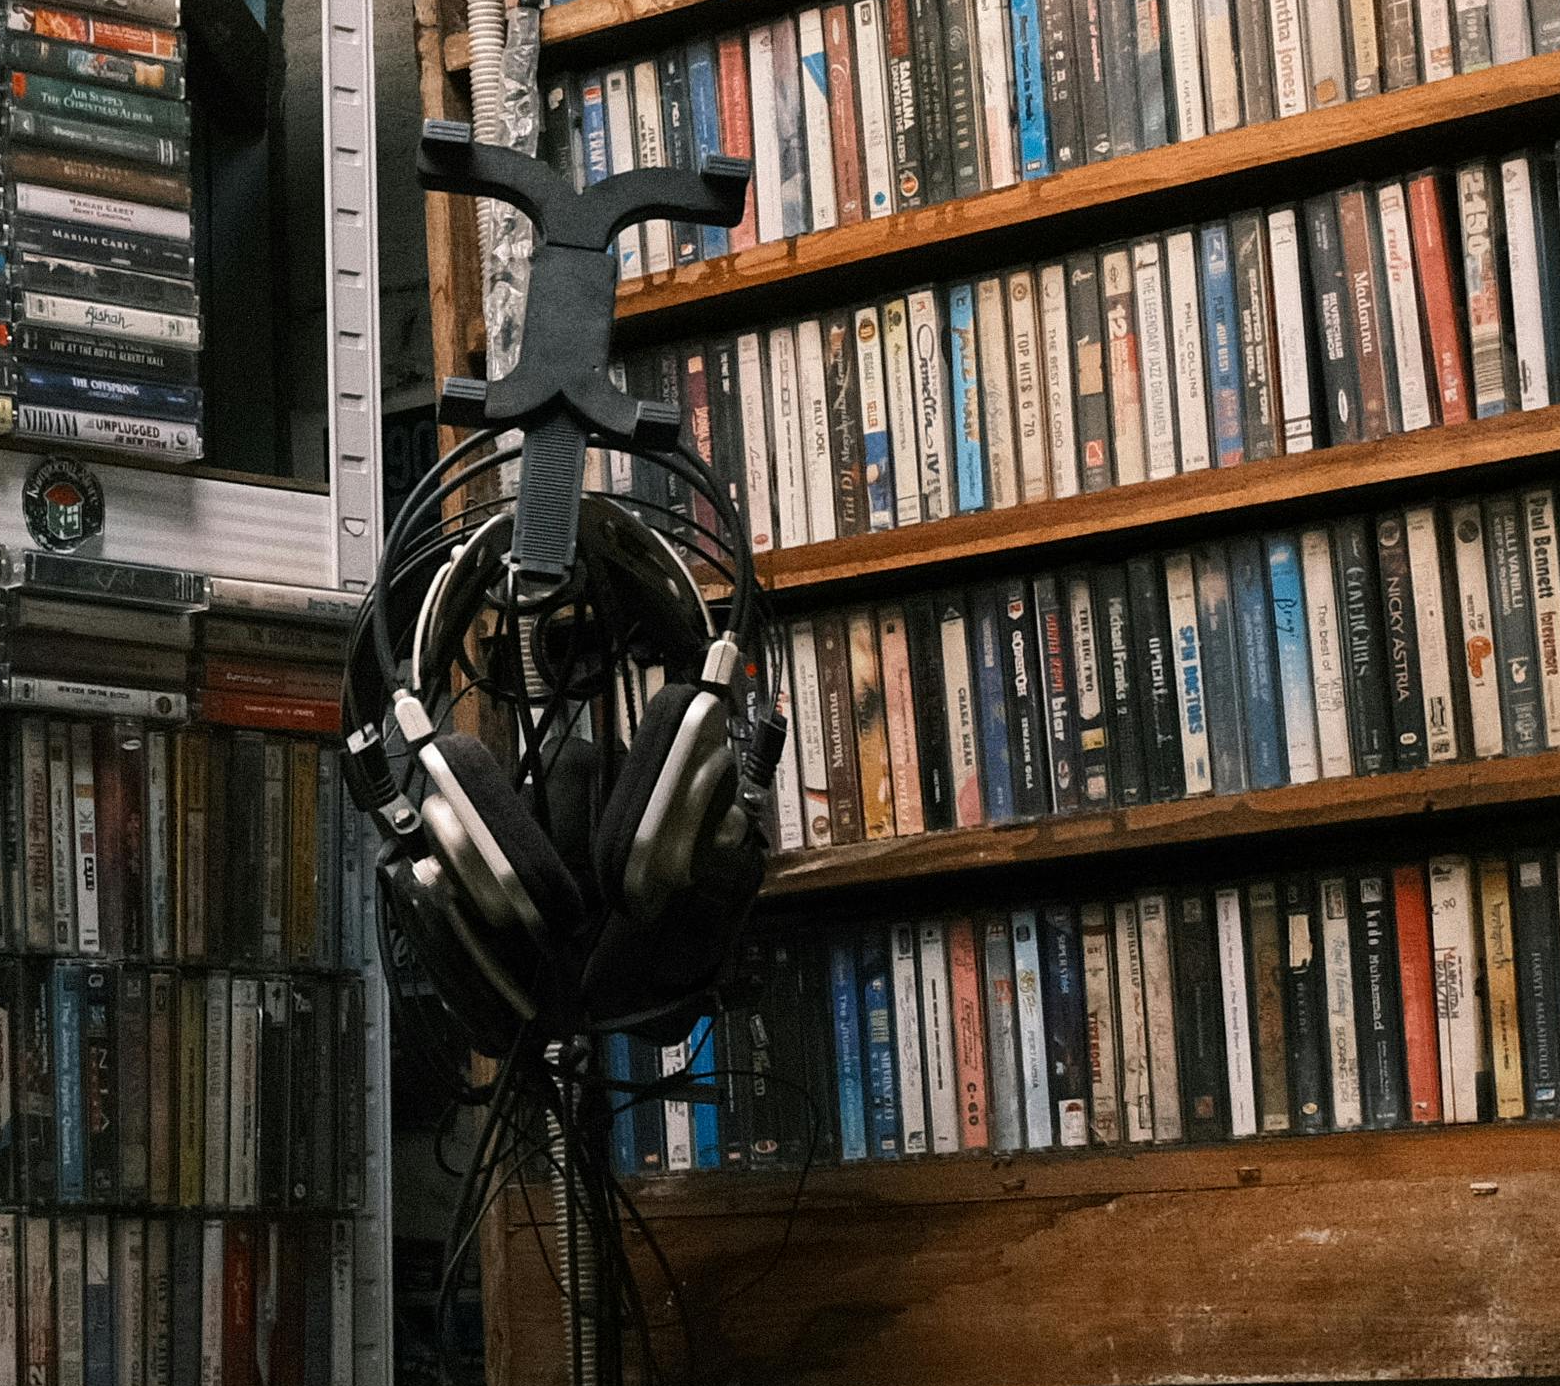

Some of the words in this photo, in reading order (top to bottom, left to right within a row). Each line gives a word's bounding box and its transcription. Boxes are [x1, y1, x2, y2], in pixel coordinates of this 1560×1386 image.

[42, 92, 61, 106] THE
[900, 60, 915, 130] SANTANA
[1276, 47, 1298, 99] jones
[52, 229, 99, 245] MARIAH
[102, 239, 137, 252] CAREY
[1386, 228, 1407, 283] radja
[1142, 276, 1156, 295] THE
[1108, 303, 1127, 339] 12
[1144, 298, 1161, 353] LEGENDARY
[1353, 271, 1373, 357] Madonna
[1017, 331, 1030, 357] TOP
[1148, 357, 1164, 378] JAZZ
[91, 380, 139, 395] OFFSPRING
[916, 324, 937, 449] Camellia
[1019, 363, 1033, 393] HITS
[22, 408, 78, 437] NIRVANA
[96, 419, 160, 438] UNPLUGGED
[1151, 381, 1166, 437] DRUMMERS
[926, 452, 940, 475] IV
[1529, 497, 1547, 531] Paul
[1509, 556, 1524, 609] VANILLI
[1534, 536, 1554, 599] Bennett
[1108, 596, 1125, 650] Michael
[1386, 577, 1404, 634] NICKY
[1179, 625, 1196, 661] SPIN
[1393, 637, 1409, 701] ASTRIA
[1540, 611, 1560, 676] forevermore
[1112, 652, 1128, 700] Franks
[1184, 666, 1203, 734] DOCTORS
[829, 691, 844, 768] Madonna
[840, 1021, 853, 1073] Ultimate
